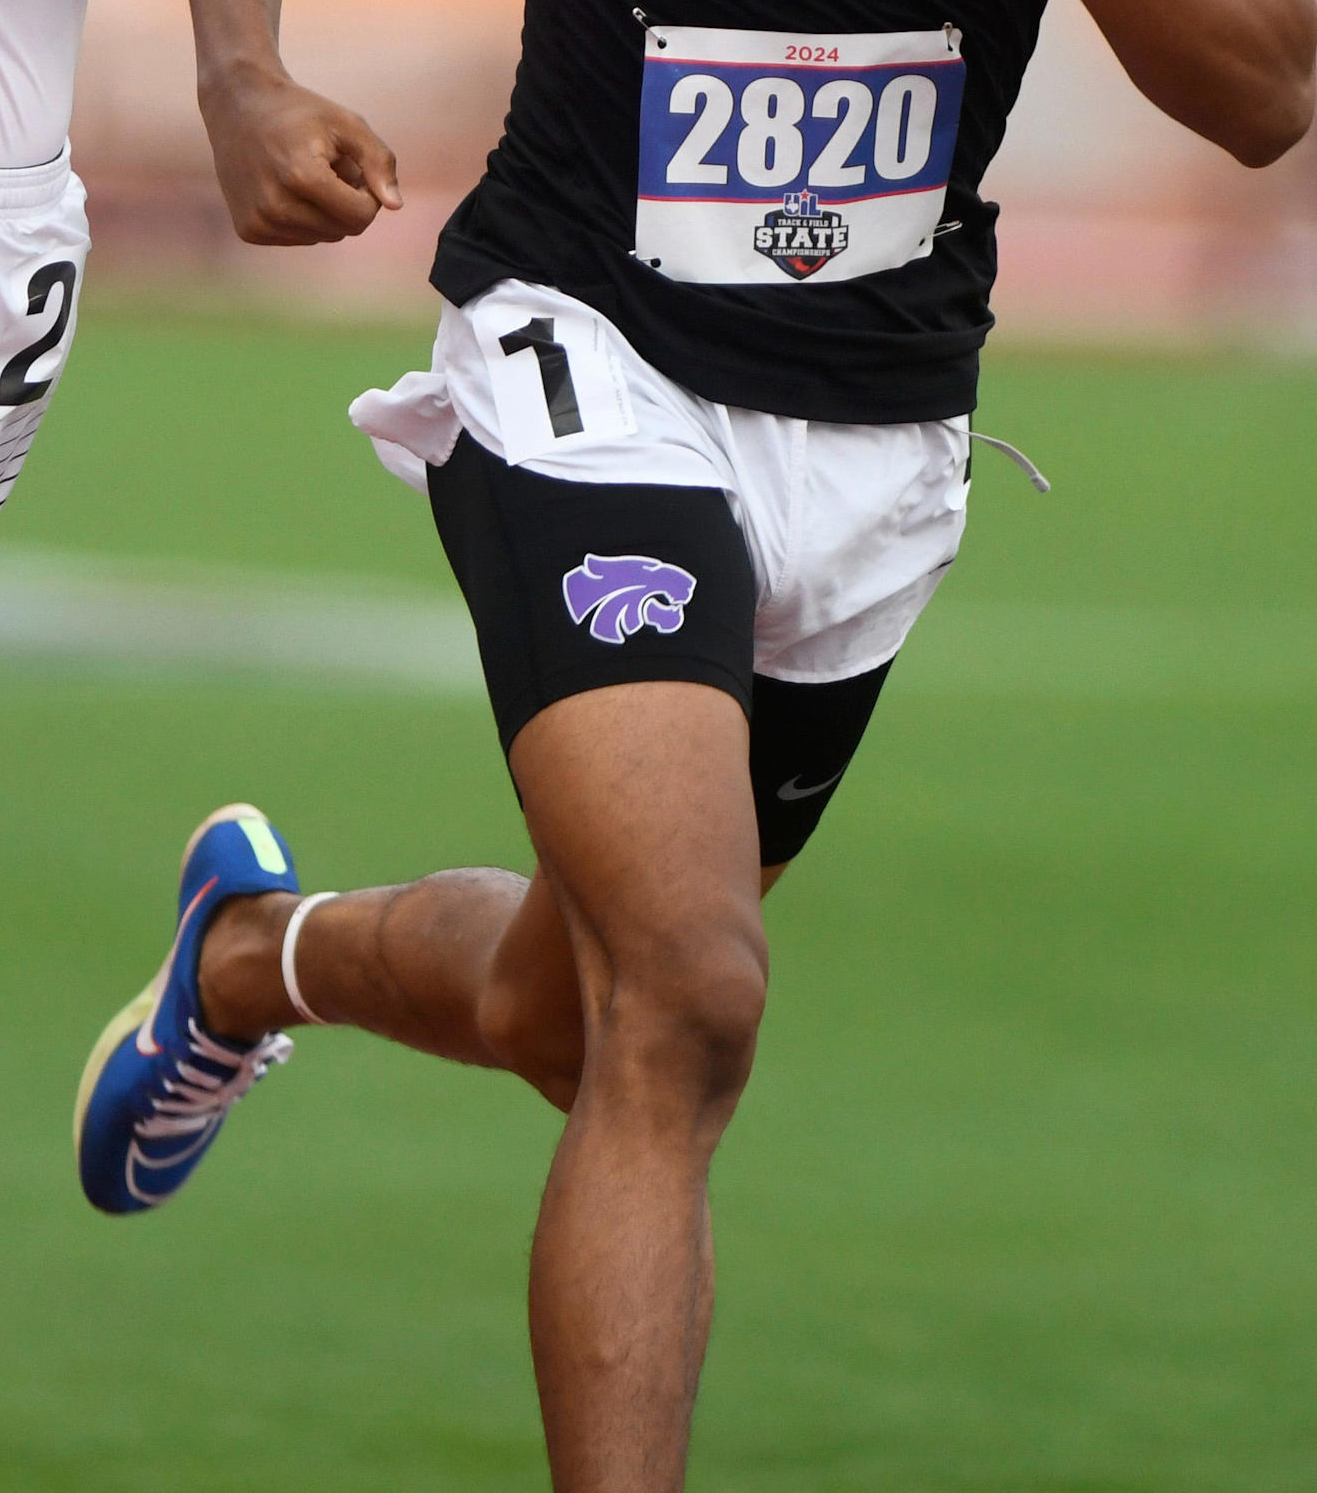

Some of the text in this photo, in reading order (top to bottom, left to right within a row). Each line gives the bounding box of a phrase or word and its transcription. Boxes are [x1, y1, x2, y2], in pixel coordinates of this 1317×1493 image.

[785, 45, 839, 62] 2024
[666, 73, 938, 188] 2820
[777, 218, 801, 227] TRACK
[808, 219, 830, 228] FIELD
[755, 227, 848, 248] STATE
[771, 248, 831, 257] CHAMPIONSHIPS
[498, 317, 585, 439] 1
